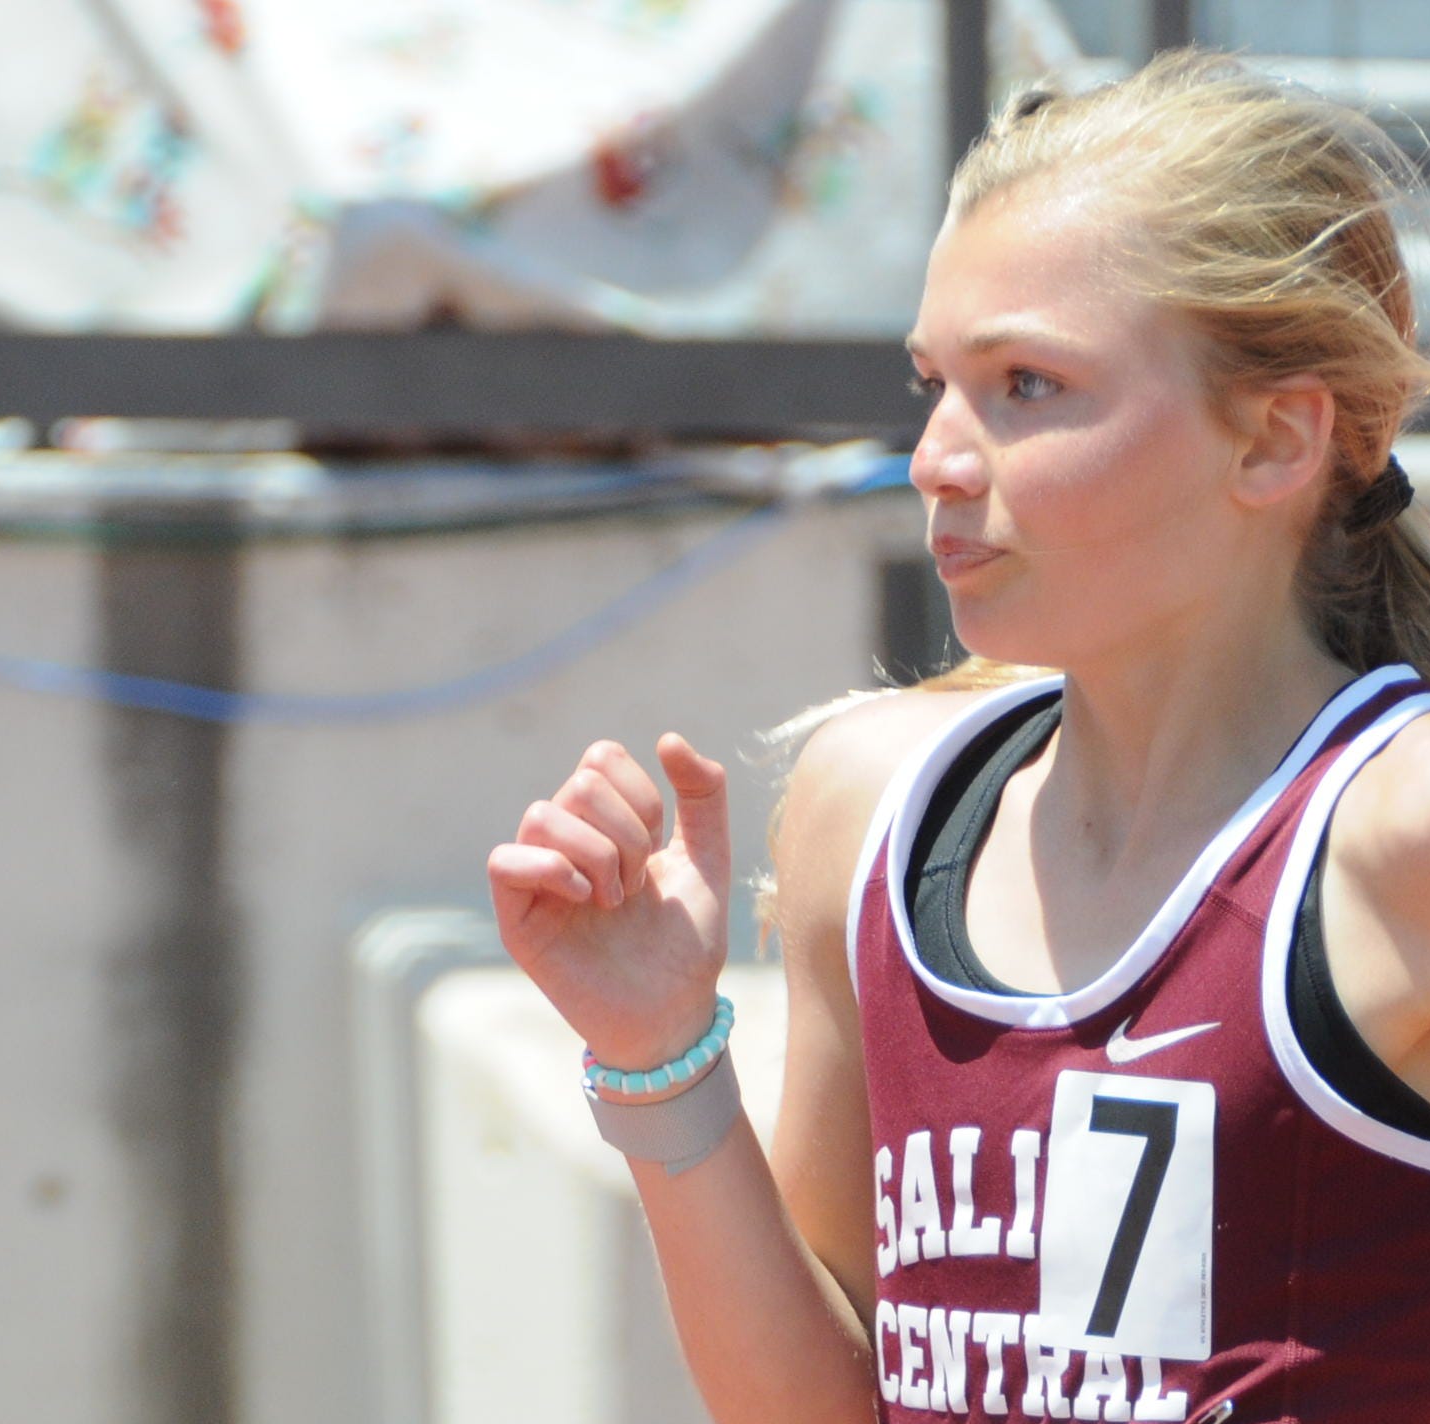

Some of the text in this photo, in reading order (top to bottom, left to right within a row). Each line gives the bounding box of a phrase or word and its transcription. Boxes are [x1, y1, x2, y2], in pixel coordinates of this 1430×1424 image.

[875, 1126, 1041, 1277] SALI
[1084, 1094, 1179, 1338] 7
[875, 1300, 1188, 1423] CENTRAL
